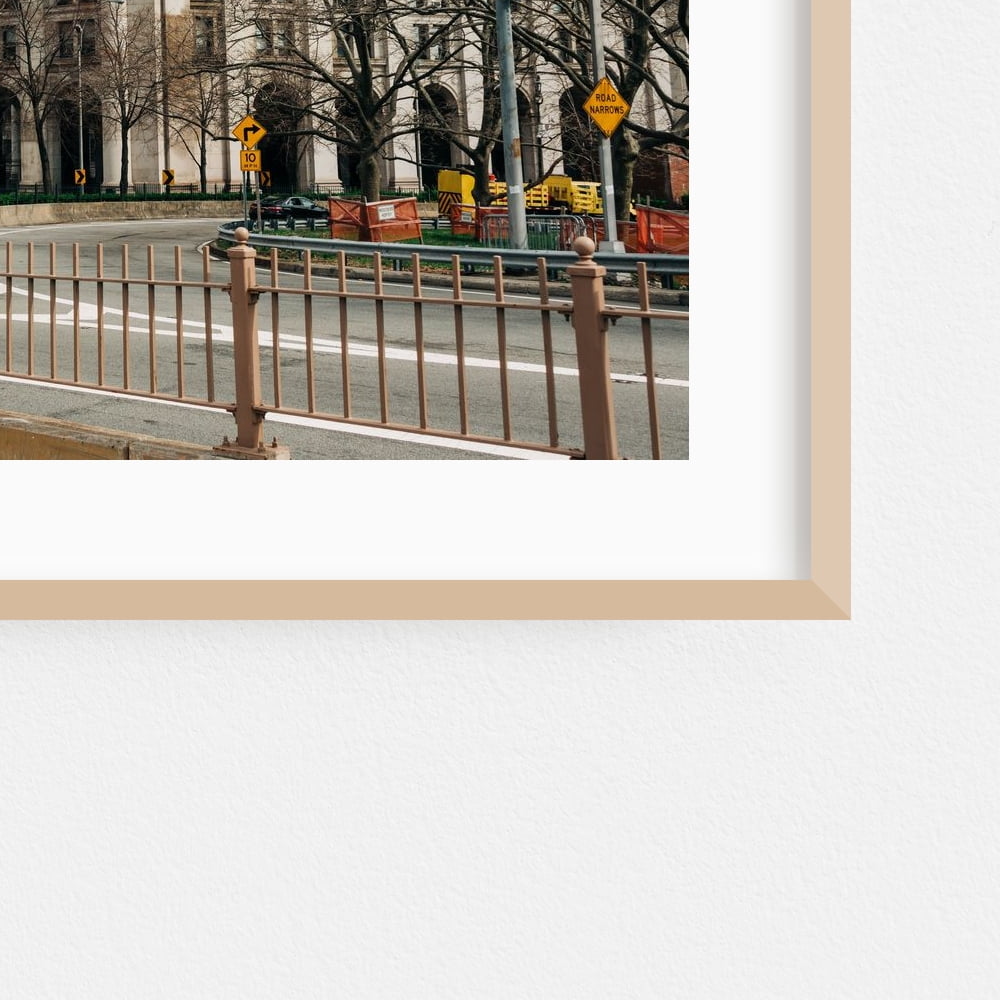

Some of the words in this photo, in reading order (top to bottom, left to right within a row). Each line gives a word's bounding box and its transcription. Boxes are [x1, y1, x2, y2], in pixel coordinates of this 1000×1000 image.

[595, 93, 617, 103] ROAD
[589, 105, 625, 115] NARROWS
[245, 152, 256, 163] 10
